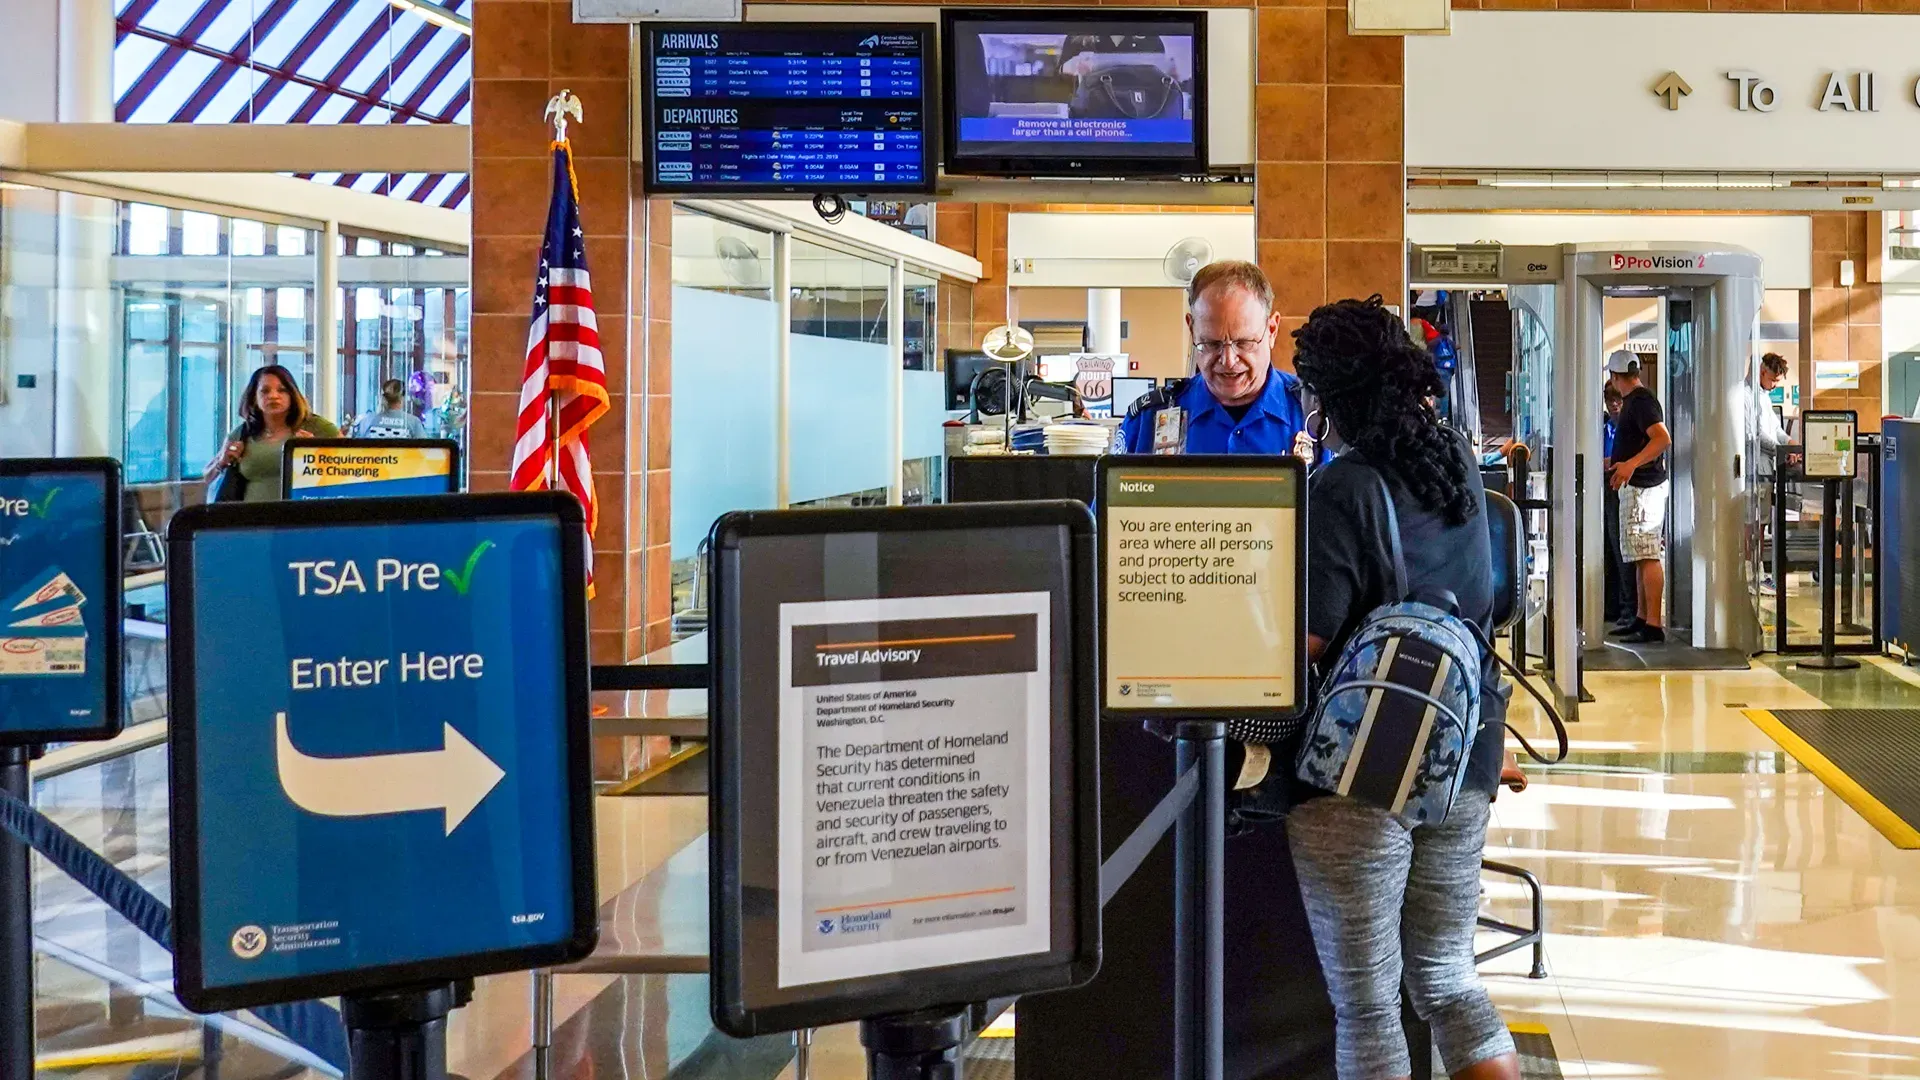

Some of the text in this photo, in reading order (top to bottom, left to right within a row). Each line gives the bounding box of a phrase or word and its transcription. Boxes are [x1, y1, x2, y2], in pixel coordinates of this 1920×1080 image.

[662, 34, 718, 49] ARRIVALS
[1727, 71, 1778, 112] To
[1819, 71, 1880, 112] All
[664, 109, 738, 124] DEPARTURES
[1018, 119, 1126, 128] Remove all electronics
[1012, 128, 1041, 137] larger
[1076, 129, 1092, 137] cell
[1095, 129, 1132, 138] phone...
[1627, 256, 1693, 269] ProVision
[1697, 256, 1705, 269] 2
[1080, 360, 1111, 370] TAILWIND
[1080, 372, 1110, 380] ROUTE
[1084, 380, 1105, 397] 66
[303, 454, 399, 466] ID Requirements
[302, 466, 380, 478] Are Changing
[1120, 482, 1155, 493] Notice
[1120, 520, 1252, 534] You are entering an
[1119, 538, 1274, 551] area where all persons
[1119, 554, 1235, 568] and property are
[288, 558, 440, 596] TSA Pre
[1118, 572, 1257, 586] subject to additional
[1118, 590, 1187, 604] screening.
[817, 648, 921, 667] Travel Advisory
[1399, 652, 1435, 668] MICHAEL KORS
[292, 652, 484, 690] Enter Here
[816, 690, 917, 704] United States of America
[817, 698, 955, 716] Department of Homeland Security
[817, 717, 867, 728] Washington,
[817, 731, 1008, 760] The Department of Homeland
[817, 751, 975, 778] Security has determined
[817, 768, 980, 795] that current conditions in
[817, 784, 1010, 813] Venezuela threaten the safety
[816, 804, 992, 832] and security of passengers,
[816, 818, 1008, 850] aircraft, and crew traveling to
[816, 837, 1002, 868] or from Venezuelan airports.
[512, 912, 544, 924] tsa.gov
[841, 909, 892, 924] Homeland
[272, 920, 339, 934] Transportation
[841, 921, 880, 934] Security
[272, 933, 310, 942] Security
[272, 937, 340, 952] Administration
